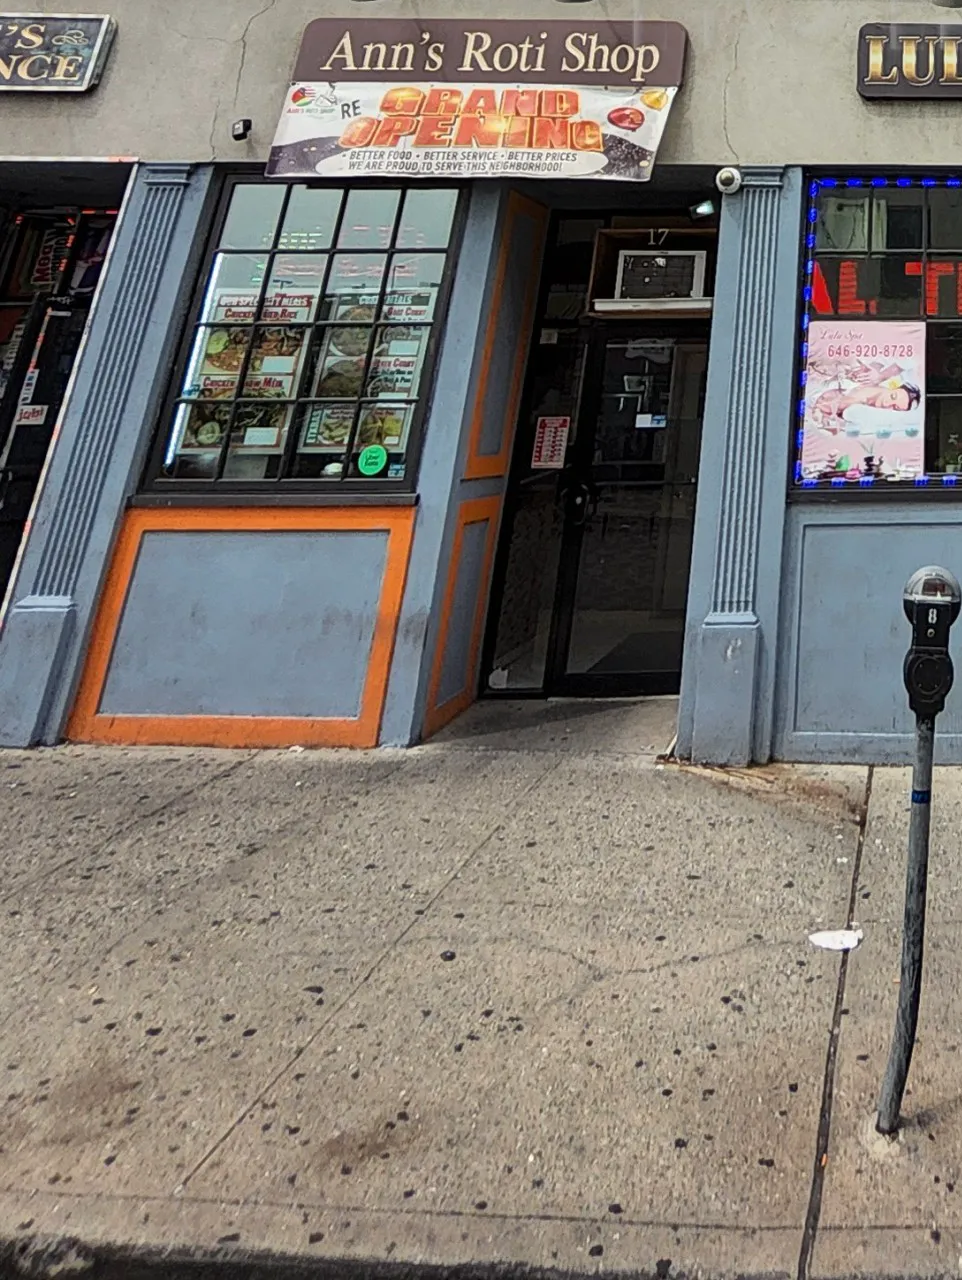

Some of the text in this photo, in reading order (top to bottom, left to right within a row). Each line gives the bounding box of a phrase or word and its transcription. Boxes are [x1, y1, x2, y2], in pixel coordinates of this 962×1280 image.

[0, 24, 46, 49] 'S
[320, 28, 660, 81] Ann's Roti Shop
[340, 99, 362, 120] RE
[378, 86, 581, 117] GRAND
[337, 116, 604, 151] OPENING
[348, 161, 563, 172] WE ARE PROUD TO SERVE THIS NEIGHBORHOOD!
[349, 150, 577, 162] BETTER FOOD BETTER SERVICE BETTER PRICES
[647, 228, 669, 246] 17
[828, 344, 913, 357] 646-920-8728
